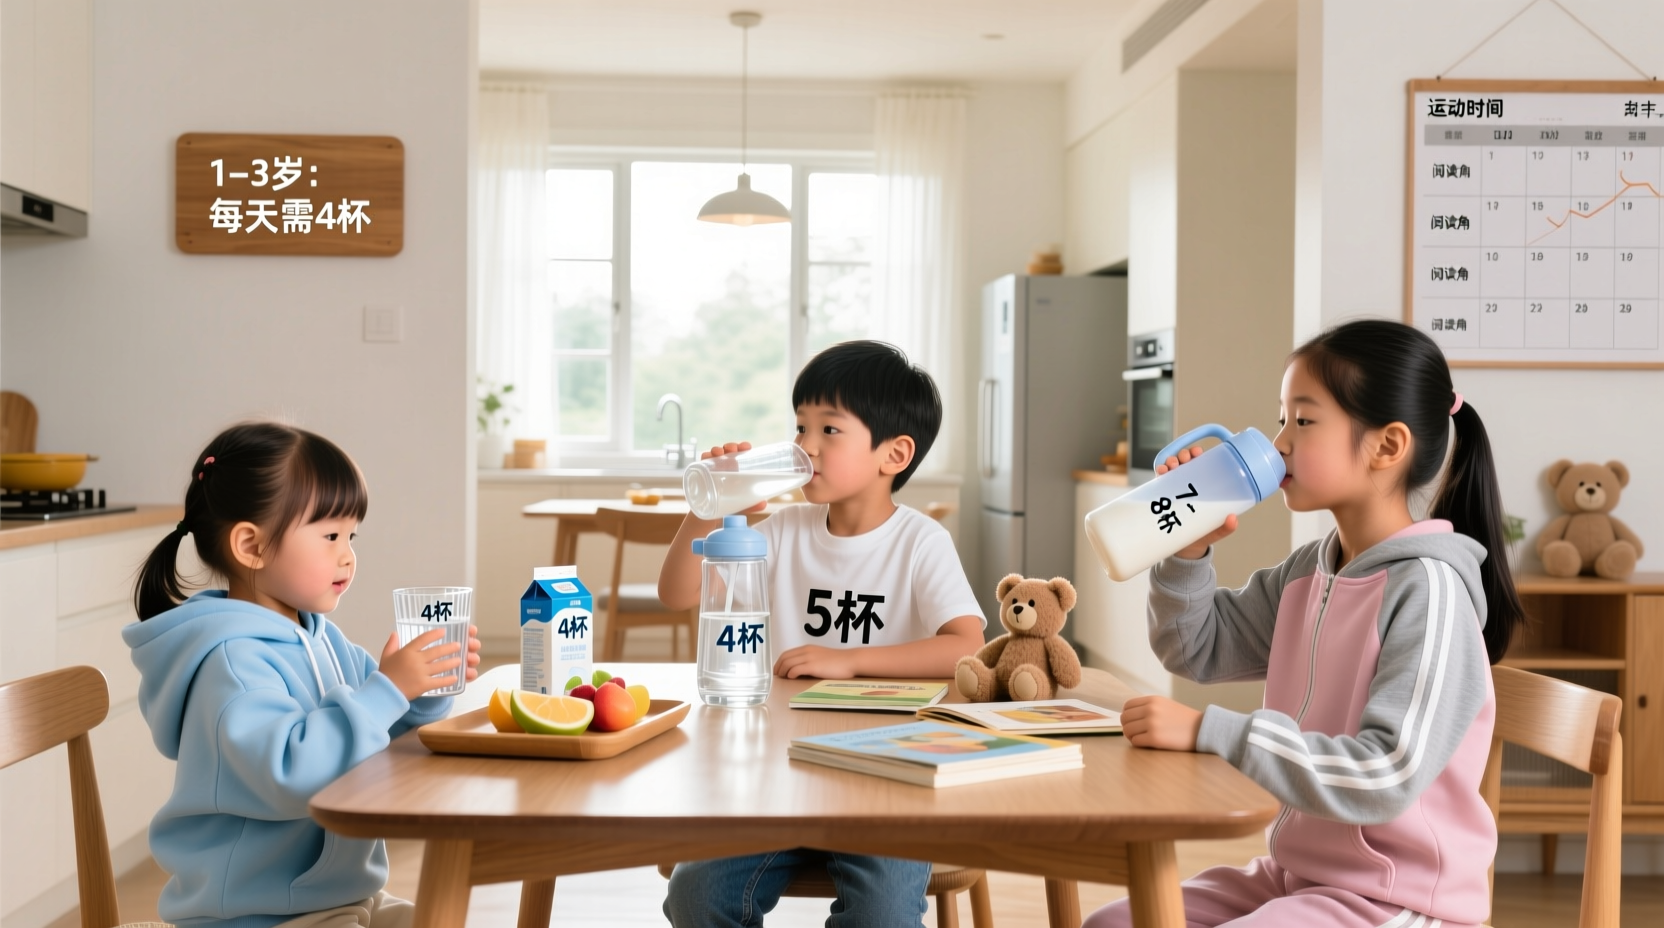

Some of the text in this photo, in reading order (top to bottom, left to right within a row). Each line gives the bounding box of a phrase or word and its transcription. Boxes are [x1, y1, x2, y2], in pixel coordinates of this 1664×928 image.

[1428, 98, 1504, 118] 运动时间
[209, 197, 372, 234] 每天需4杯
[420, 600, 453, 622] 4杯
[804, 588, 885, 644] 5杯
[558, 615, 588, 639] 4杯
[716, 622, 764, 654] 4杯
